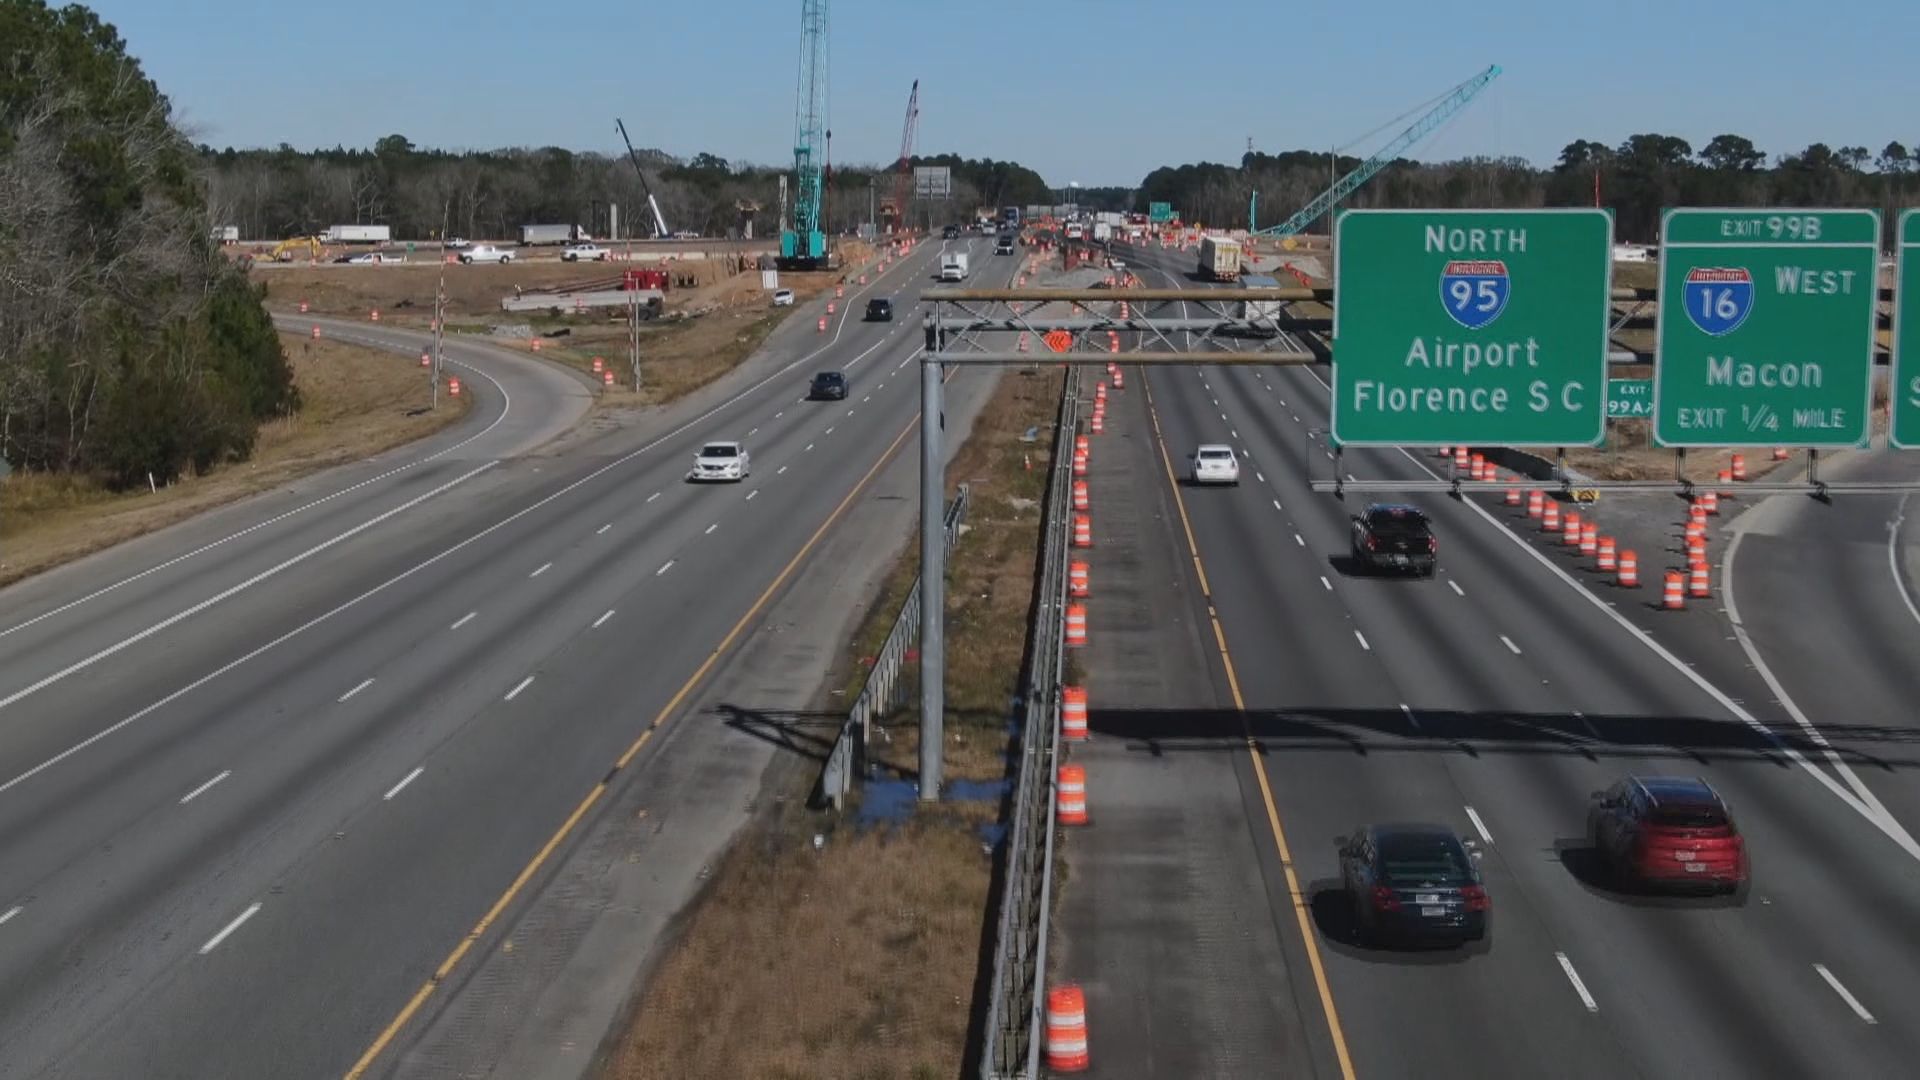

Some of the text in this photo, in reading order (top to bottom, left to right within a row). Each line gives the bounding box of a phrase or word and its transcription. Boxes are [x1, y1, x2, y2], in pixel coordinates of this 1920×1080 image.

[1424, 224, 1528, 253] NORTH
[1720, 216, 1821, 241] EXIT 99B
[1774, 266, 1855, 294] WEST
[1450, 280, 1499, 312] 95
[1701, 287, 1739, 320] 16
[1405, 337, 1540, 375] Airport
[1706, 356, 1822, 387] Macon
[1353, 381, 1584, 412] Florence S C
[1620, 385, 1646, 395] EXIT
[1677, 407, 1726, 429] EXIT
[1792, 408, 1846, 428] MILE
